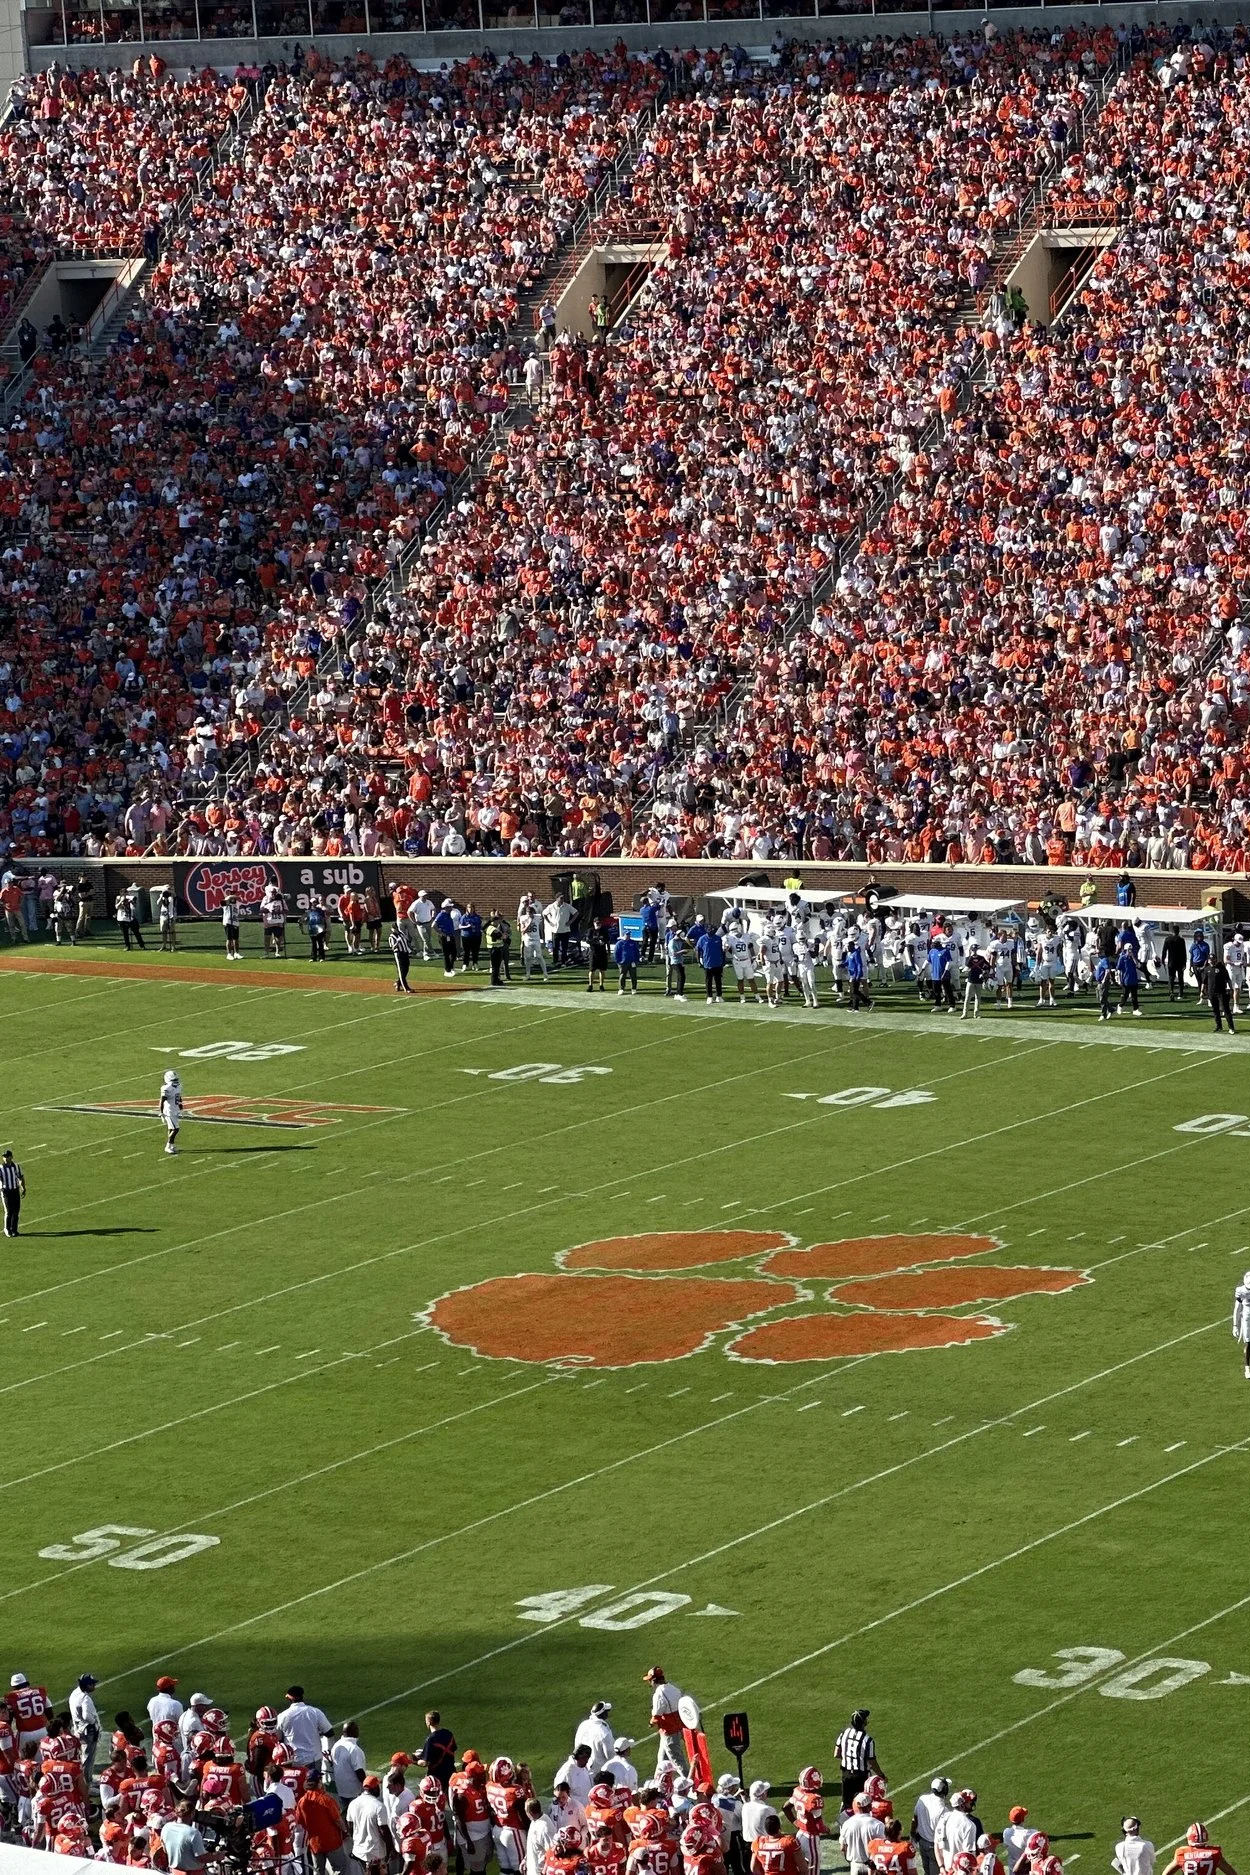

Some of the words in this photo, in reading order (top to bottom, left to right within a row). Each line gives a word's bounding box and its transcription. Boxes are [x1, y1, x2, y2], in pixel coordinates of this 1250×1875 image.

[197, 865, 267, 891] Jersey
[300, 869, 314, 885] a
[323, 863, 364, 885] sub
[179, 1041, 307, 1062] 20
[487, 1063, 614, 1084] 30
[816, 1086, 940, 1108] 40
[38, 1525, 221, 1570] 50
[513, 1584, 692, 1631] 40
[1012, 1646, 1211, 1700] 30
[17, 1696, 44, 1719] 56
[757, 1850, 786, 1872] 77
